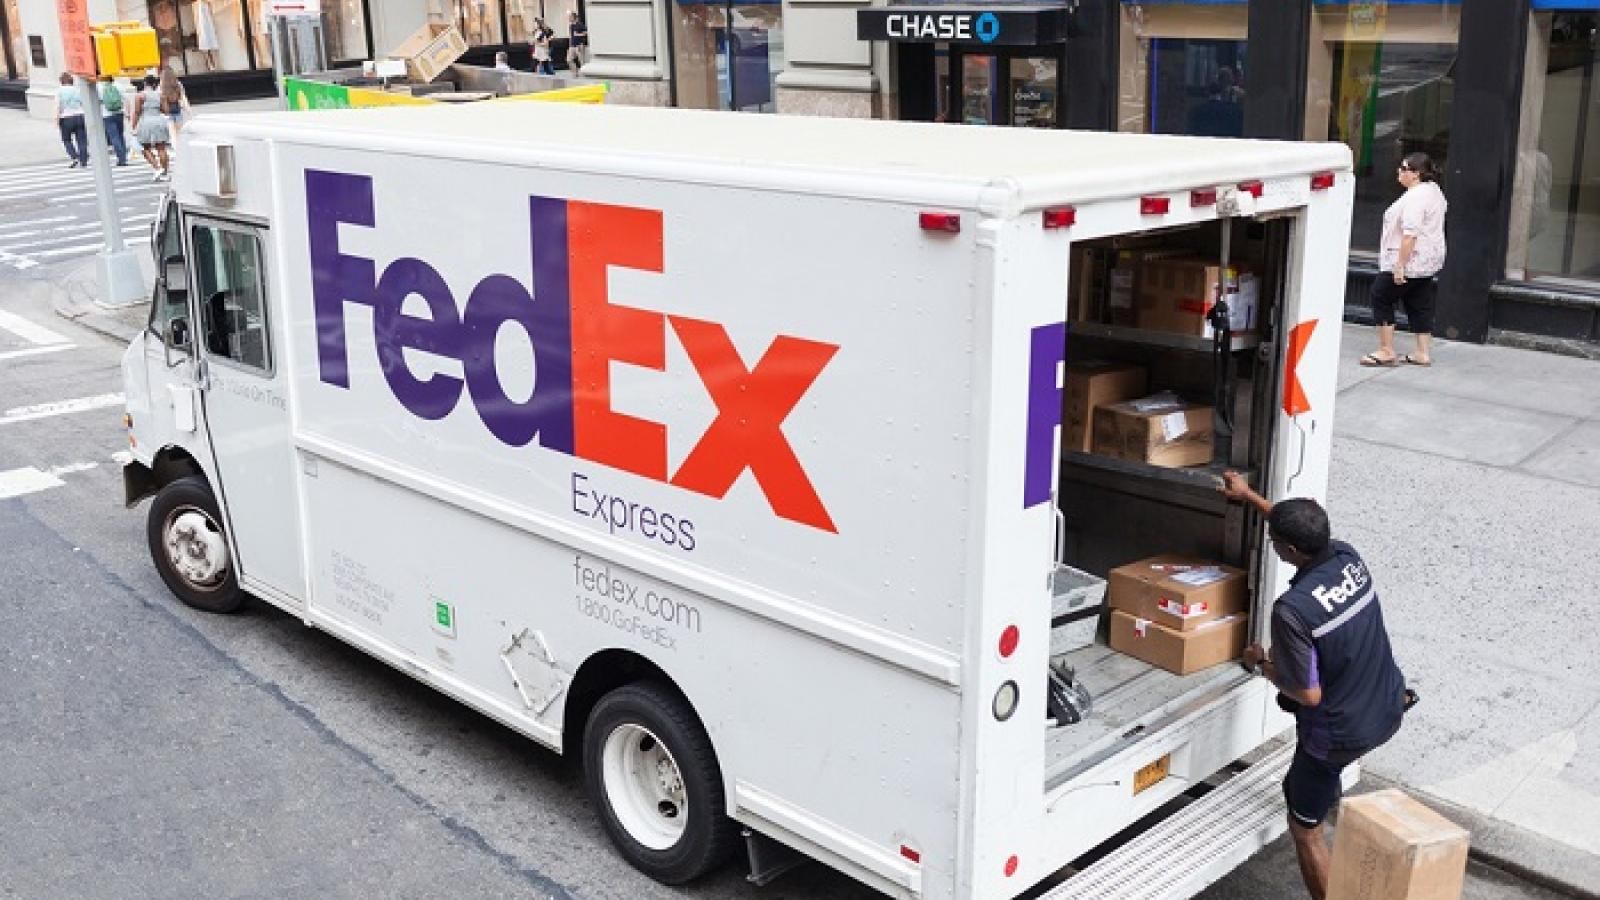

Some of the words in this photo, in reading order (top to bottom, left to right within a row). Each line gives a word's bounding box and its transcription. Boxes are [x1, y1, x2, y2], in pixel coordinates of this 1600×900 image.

[886, 14, 972, 39] CHASE
[305, 168, 840, 534] FedEx
[570, 471, 697, 552] Express
[573, 555, 702, 633] fedex.com
[575, 594, 678, 651] 1.800.GoFedEx
